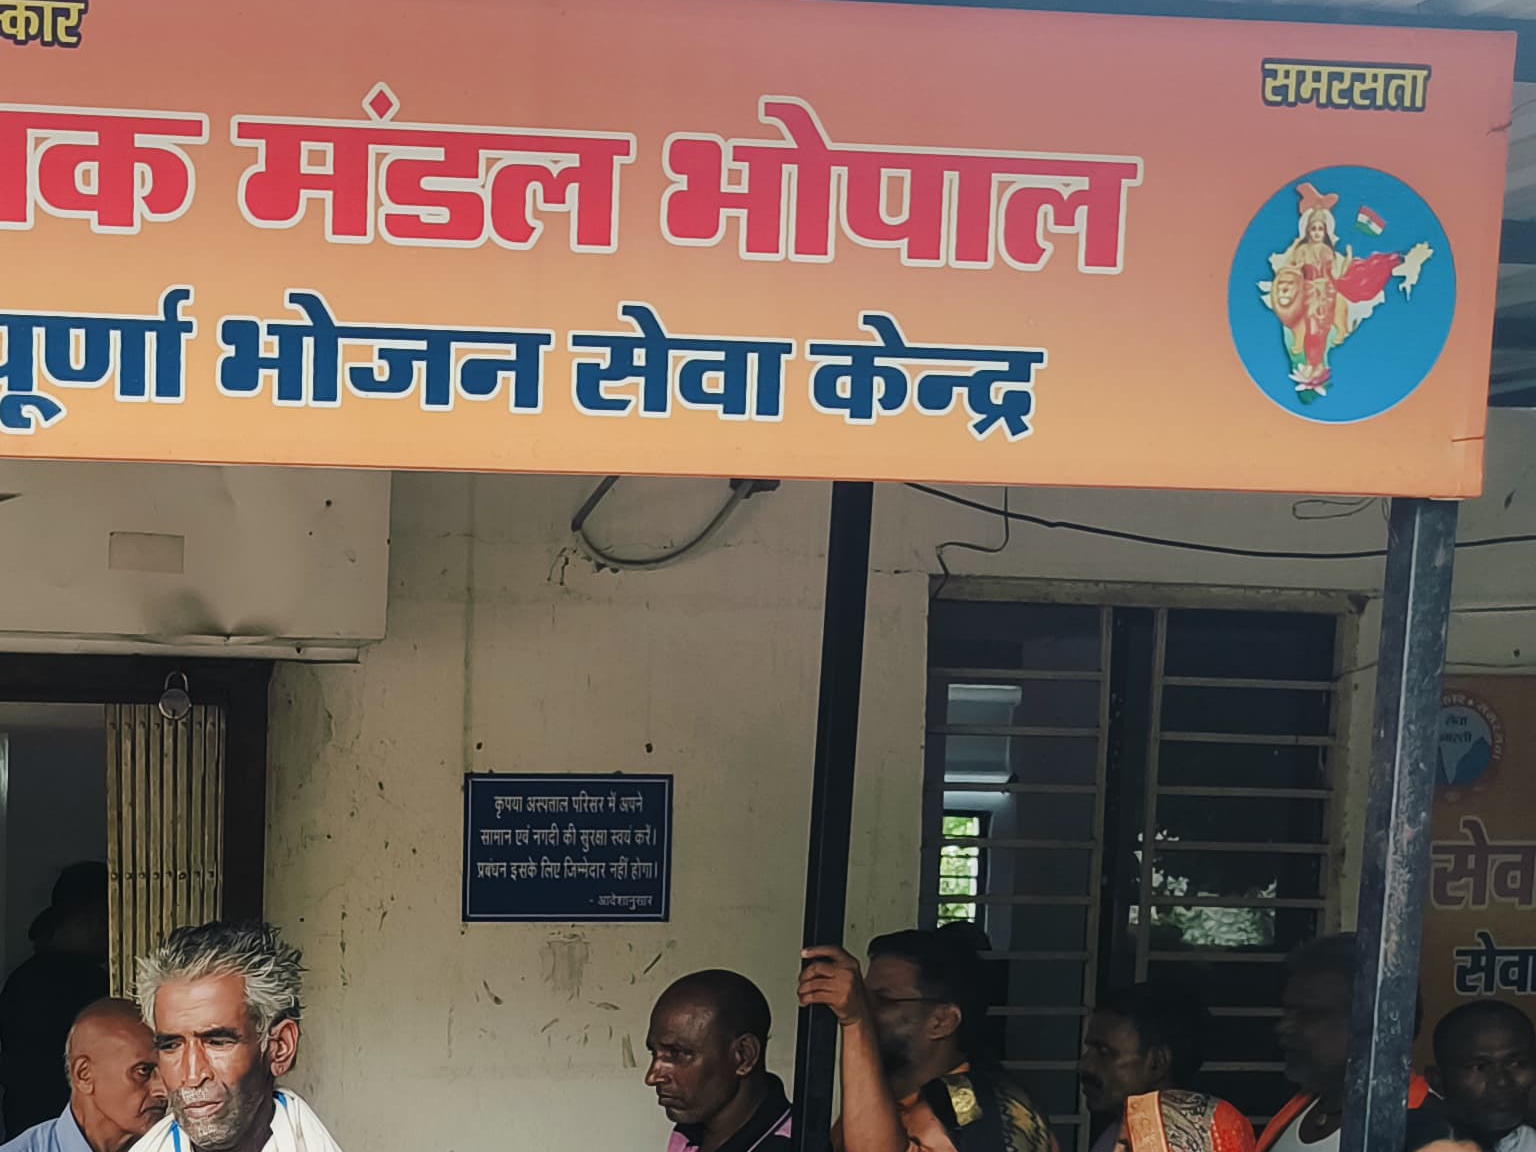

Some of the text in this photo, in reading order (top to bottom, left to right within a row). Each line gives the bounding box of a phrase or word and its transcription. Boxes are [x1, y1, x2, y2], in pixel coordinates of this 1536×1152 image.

[1262, 59, 1431, 112] समरसता
[231, 81, 637, 254] मंडल
[660, 95, 1144, 274] भोपाल
[216, 287, 556, 417] भोजन
[568, 302, 793, 421] सेवा
[806, 310, 1048, 442] केन्द्र
[494, 790, 643, 818] कृपया अस्पताल परिसर में अपने
[480, 829, 512, 845] सामान
[515, 824, 530, 845] एवं
[533, 823, 559, 845] नगदी
[563, 823, 576, 845] की
[579, 828, 607, 852] सुरक्षा
[611, 825, 632, 845] स्वयं
[477, 858, 507, 879] प्रबंधन
[510, 856, 538, 880] इसके
[540, 856, 561, 879] लिए
[563, 856, 606, 879] जिम्मेदार
[609, 856, 628, 880] नहीं
[1431, 815, 1536, 910] सेव
[598, 892, 653, 910] आदेशानुसार
